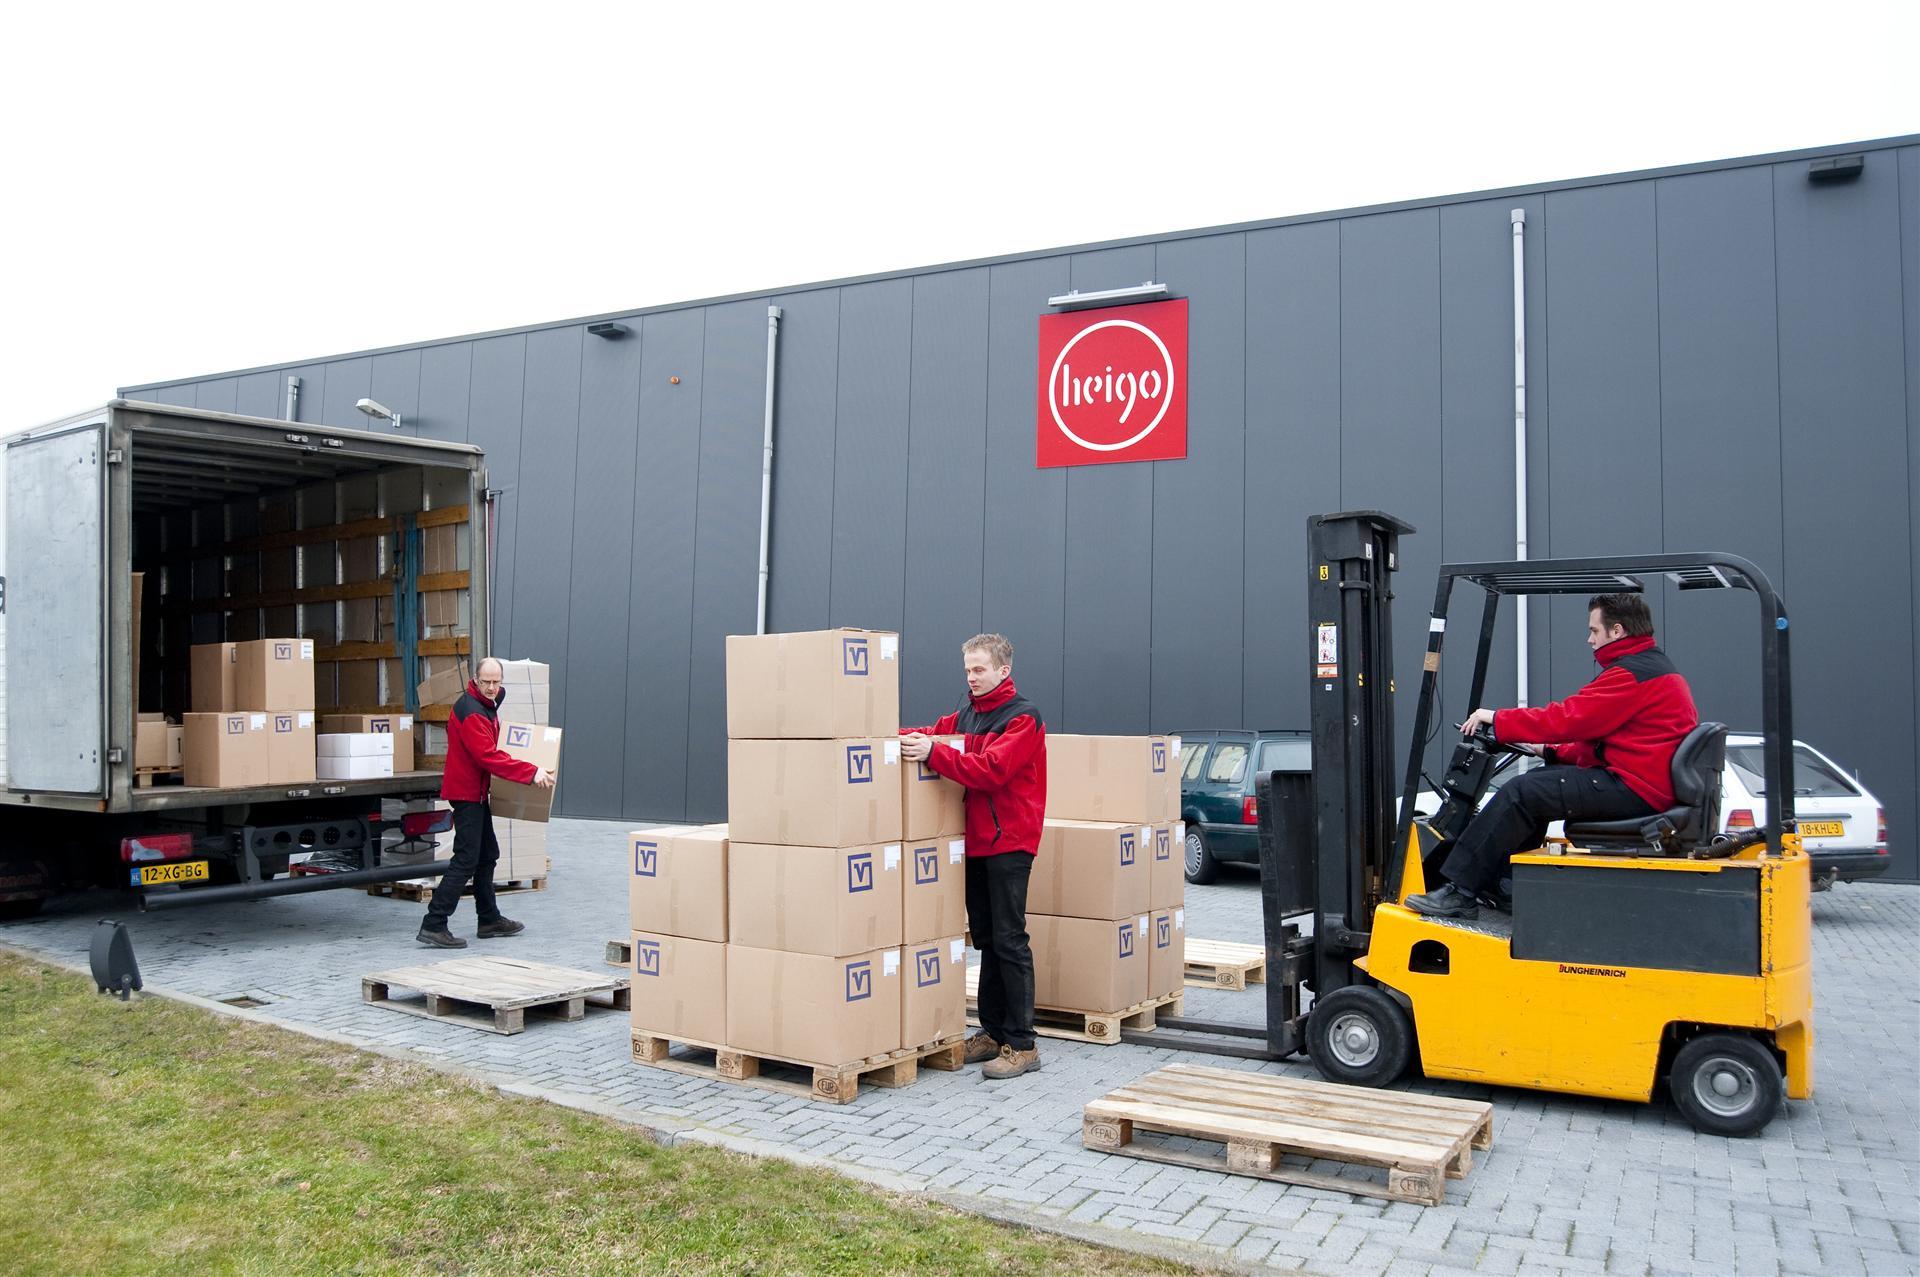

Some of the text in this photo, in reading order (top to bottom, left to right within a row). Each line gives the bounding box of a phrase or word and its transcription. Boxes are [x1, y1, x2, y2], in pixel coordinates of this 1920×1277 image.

[1062, 364, 1162, 424] heigo
[1801, 823, 1840, 835] 18-KHL-3
[144, 864, 202, 881] 12-XG-BG
[1559, 964, 1626, 977] JUNGHEINRICH
